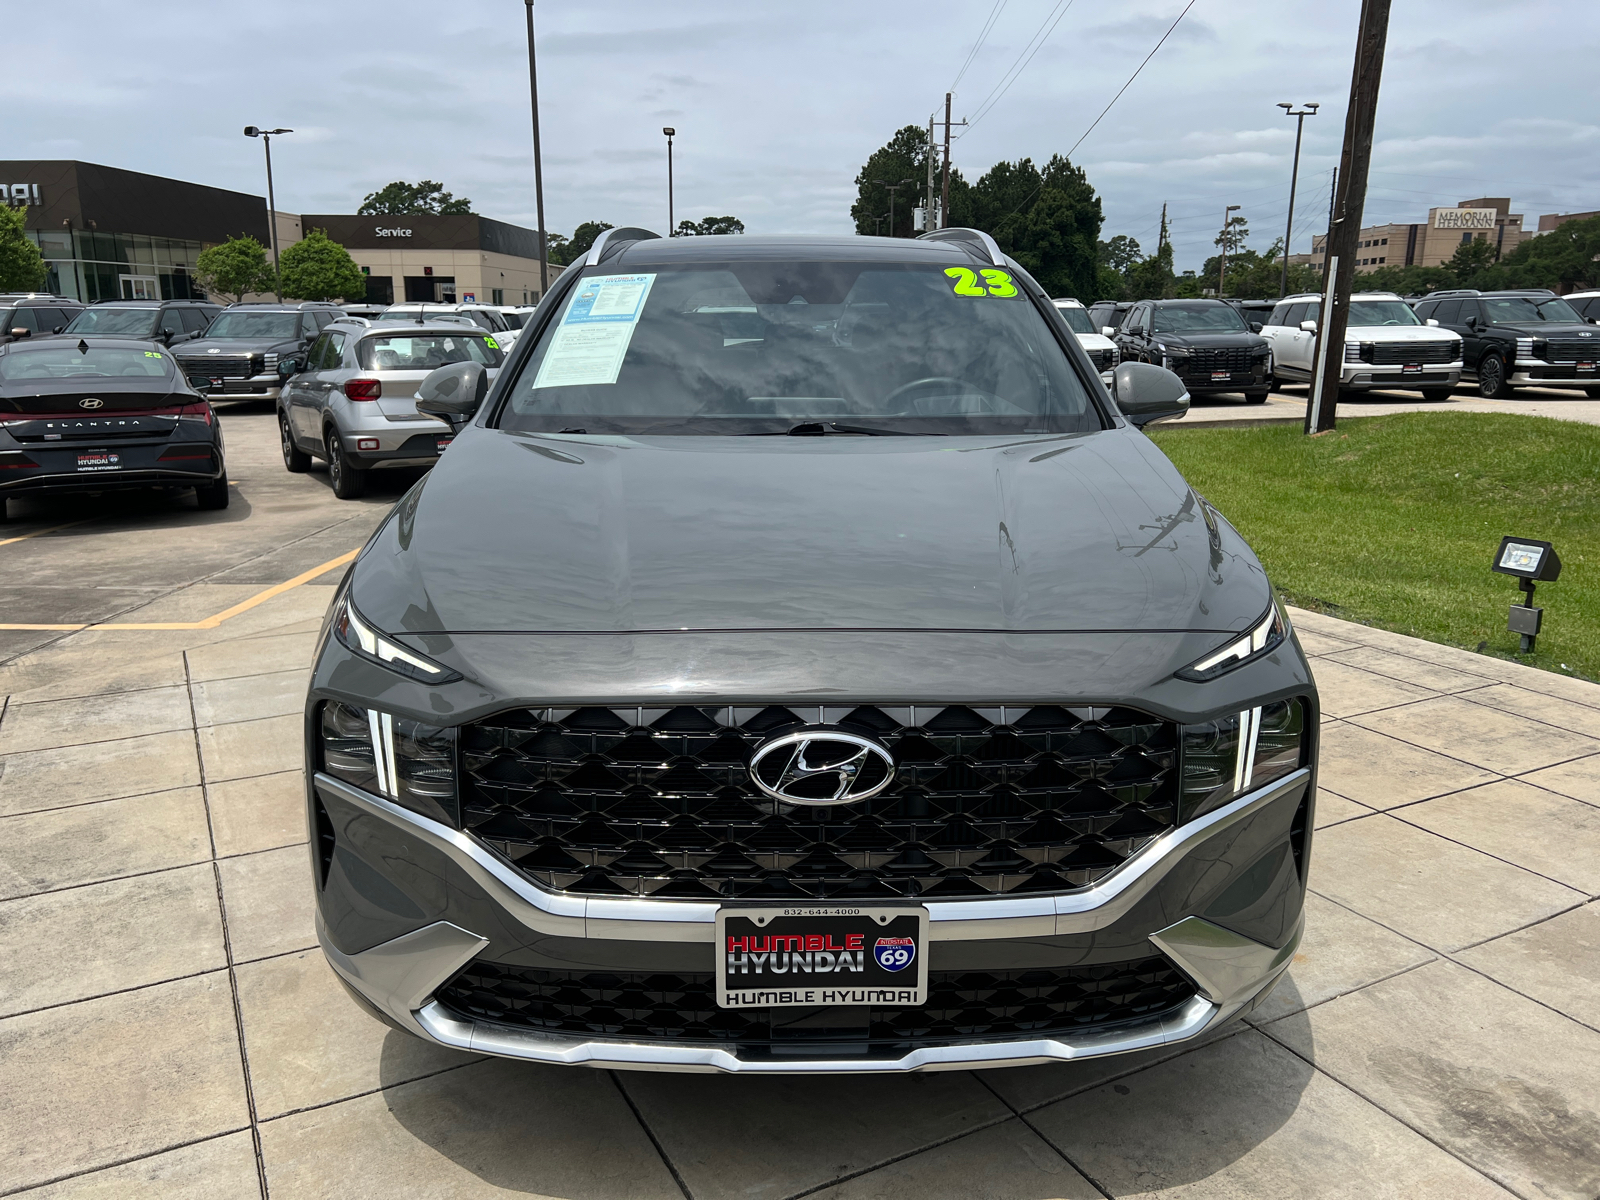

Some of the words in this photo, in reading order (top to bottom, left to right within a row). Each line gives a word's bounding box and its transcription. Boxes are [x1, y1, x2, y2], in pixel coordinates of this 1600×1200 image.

[1440, 212, 1493, 220] MEMORIAL
[375, 226, 413, 237] Service
[943, 266, 1019, 298] 23
[46, 420, 140, 428] ELANTRA
[728, 934, 865, 952] HUMBLE
[728, 951, 865, 974] HYUNDAI
[880, 950, 909, 966] 69
[726, 991, 815, 1005] HUMBLE
[823, 990, 918, 1003] HYUNDAI
